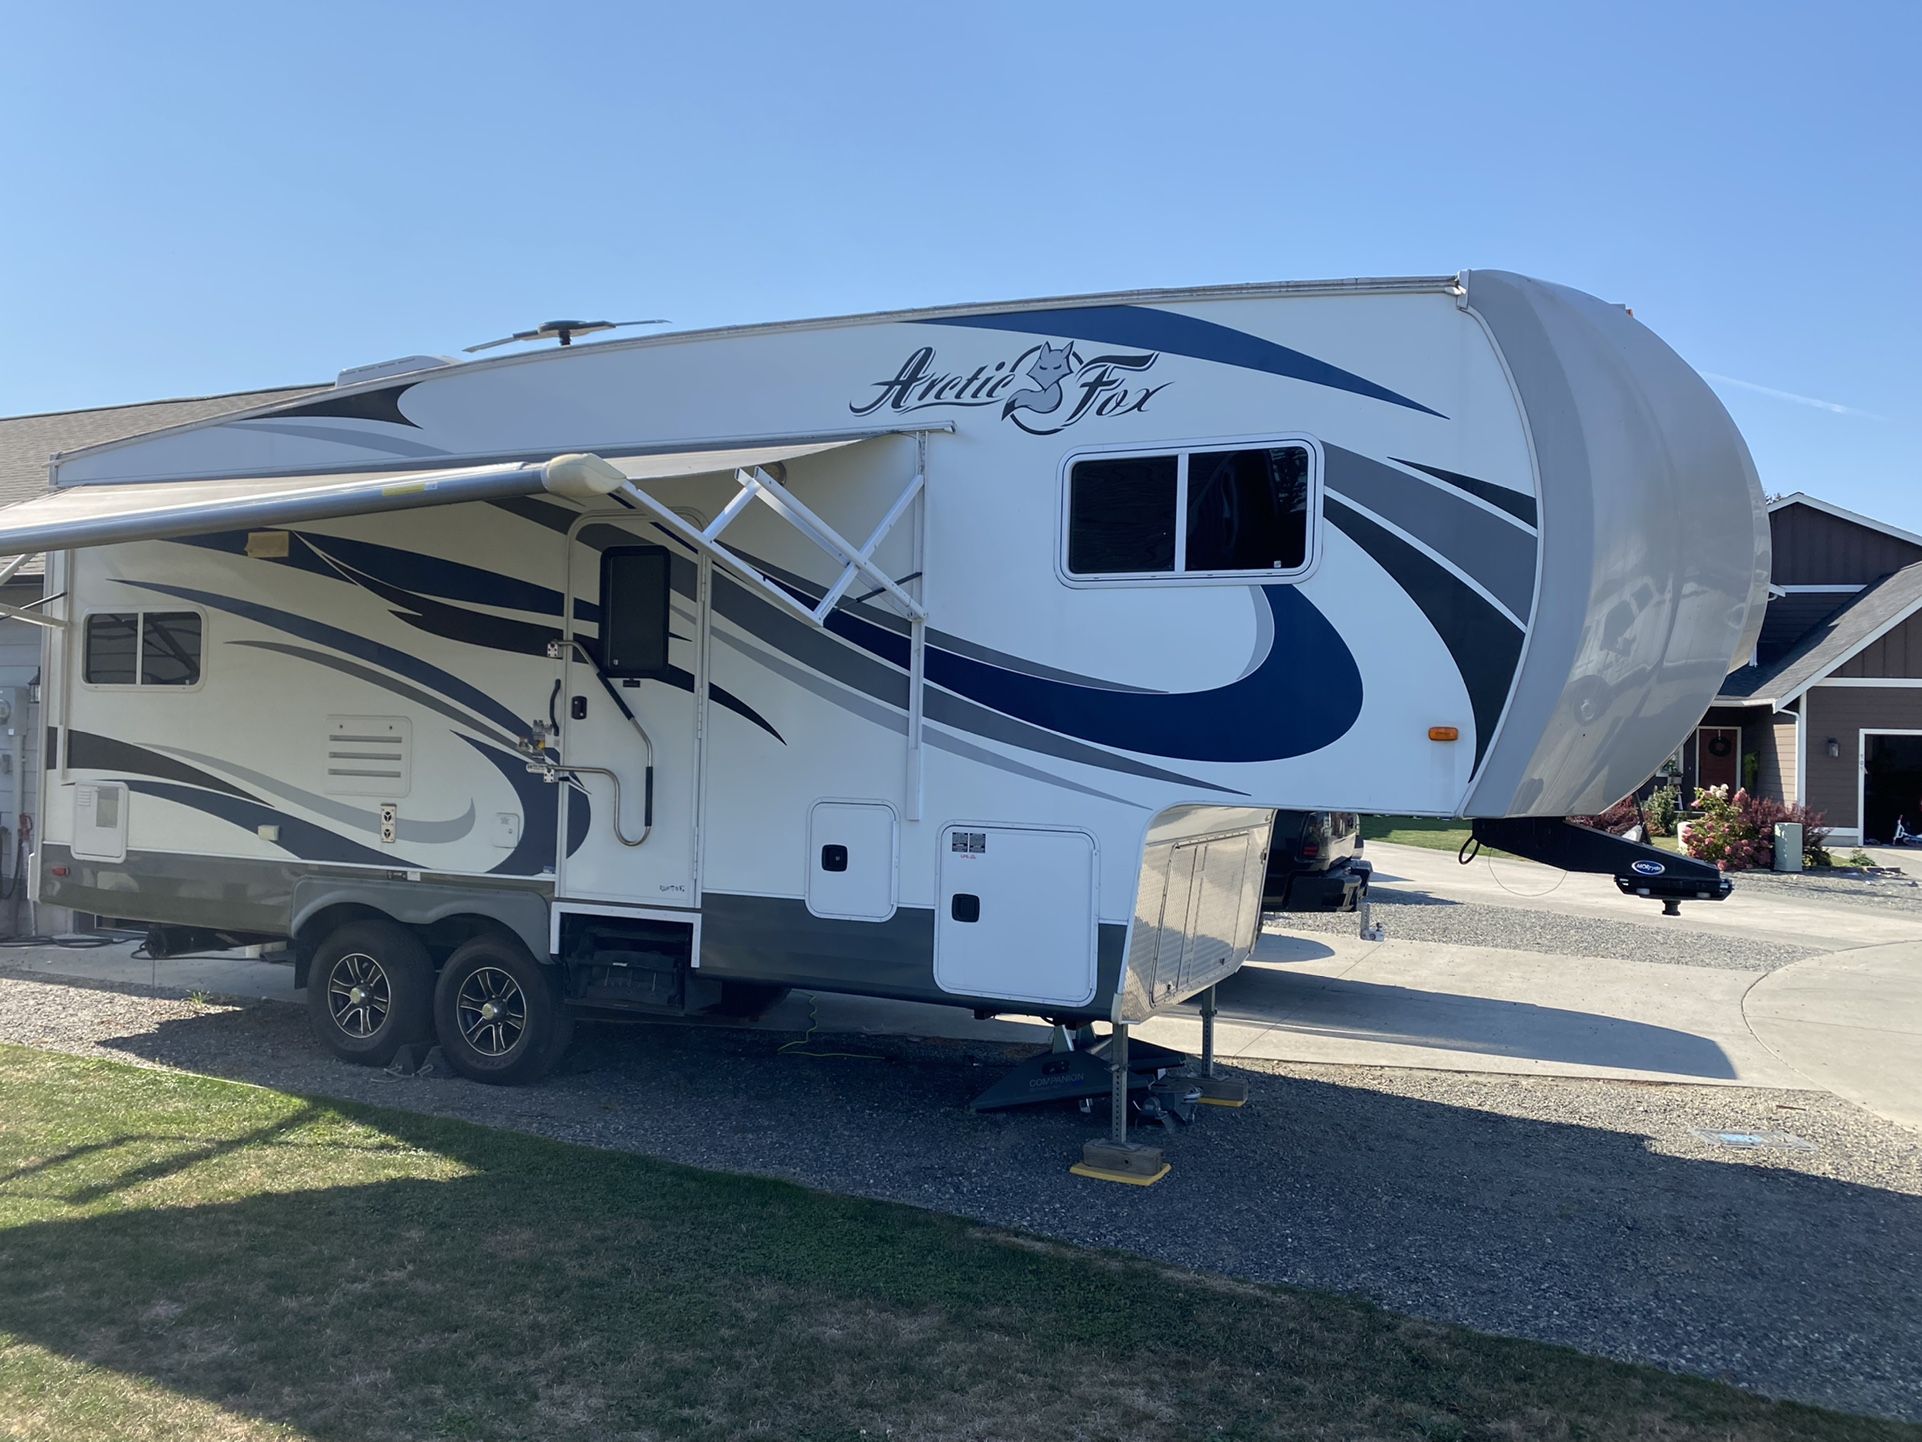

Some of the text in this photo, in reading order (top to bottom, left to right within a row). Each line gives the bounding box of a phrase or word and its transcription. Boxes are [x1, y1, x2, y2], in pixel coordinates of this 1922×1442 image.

[849, 346, 1176, 428] Arctic Fox
[1029, 1072, 1085, 1088] COMPANION
